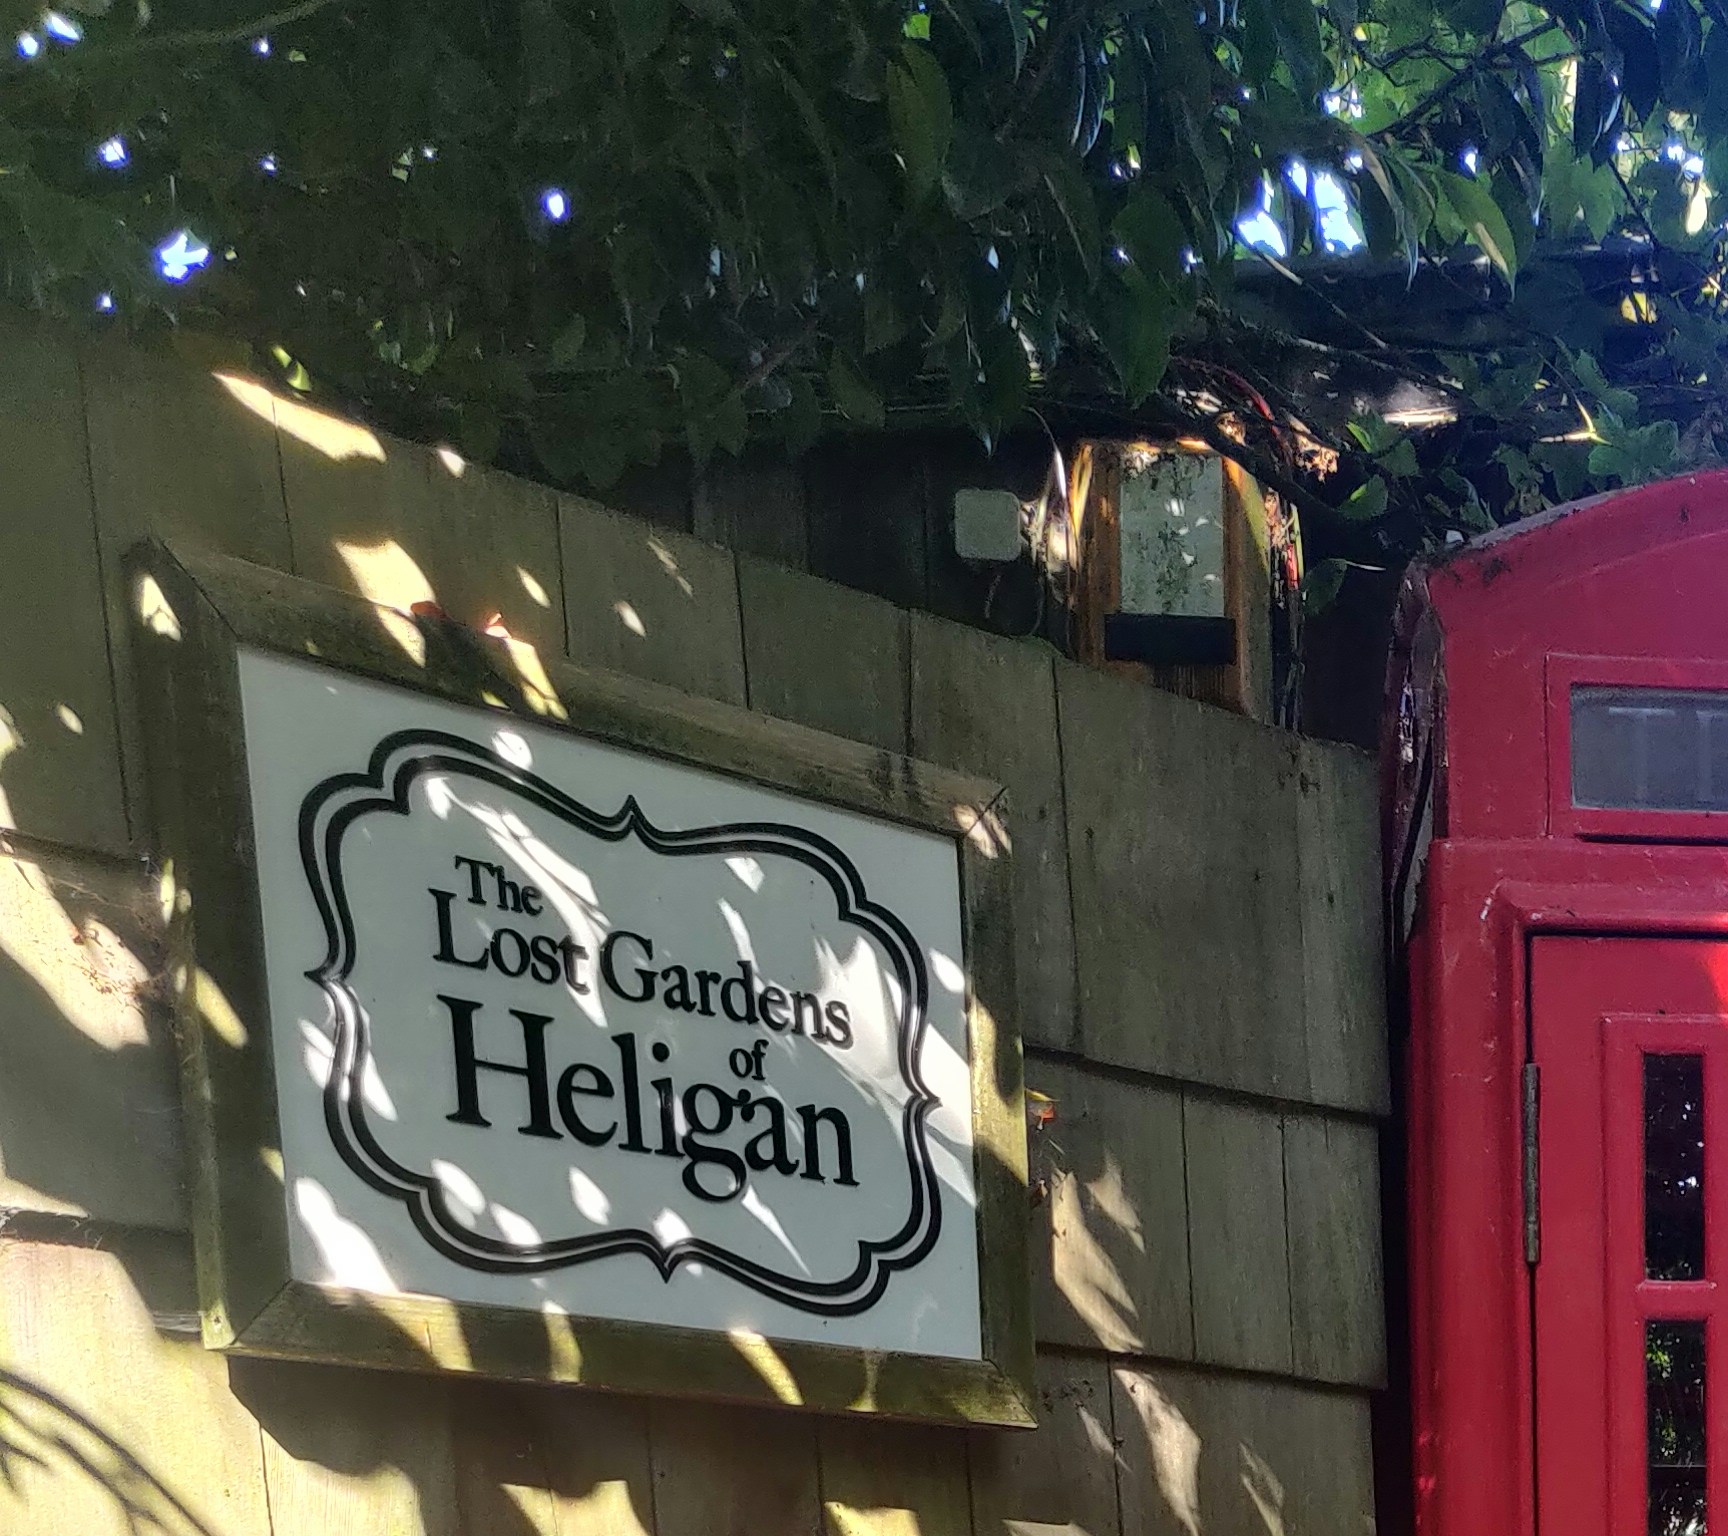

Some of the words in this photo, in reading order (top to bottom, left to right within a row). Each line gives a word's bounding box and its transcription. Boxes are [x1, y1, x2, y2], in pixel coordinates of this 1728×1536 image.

[454, 854, 544, 917] The
[427, 887, 591, 996] Lost
[601, 929, 855, 1050] Gardens
[436, 993, 861, 1204] Heligan
[728, 1038, 770, 1082] of
